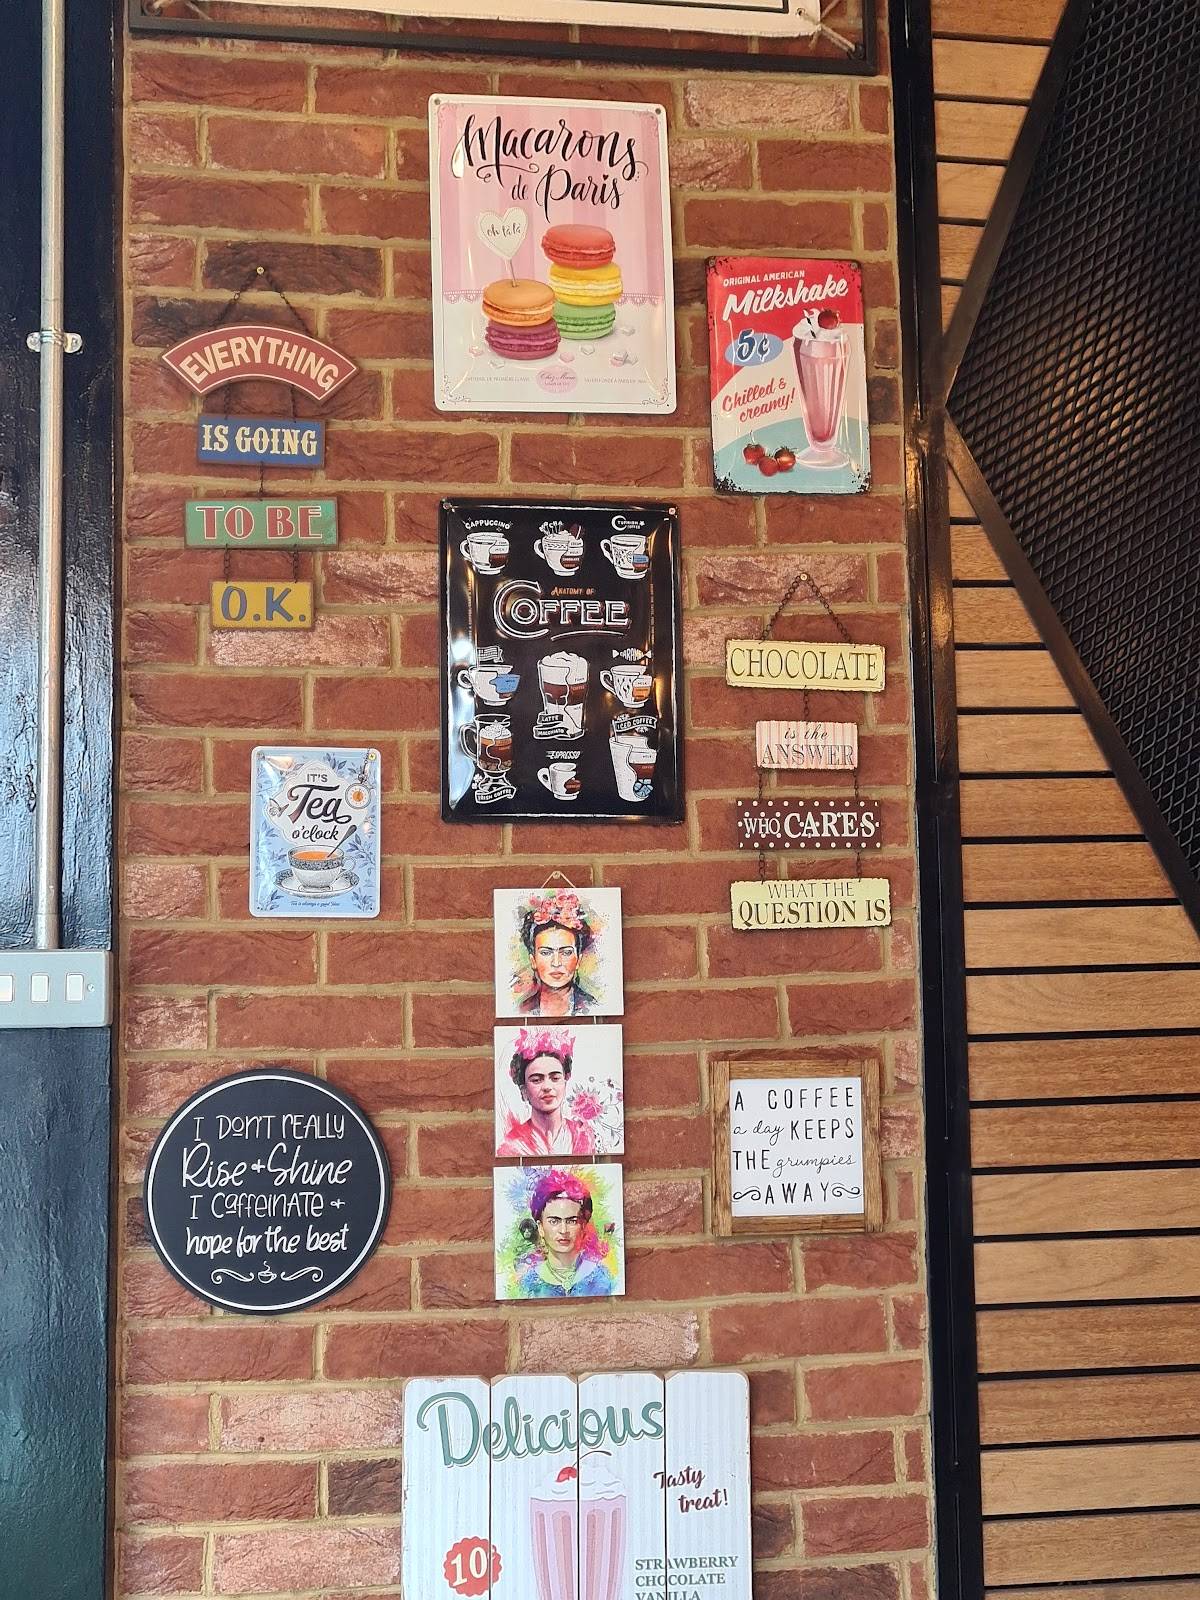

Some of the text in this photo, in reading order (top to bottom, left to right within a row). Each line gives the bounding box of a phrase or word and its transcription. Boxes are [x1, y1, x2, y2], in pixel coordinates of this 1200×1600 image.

[452, 114, 649, 187] Macarons
[511, 164, 624, 224] de Paris
[723, 270, 806, 287] ORIGINAL AMERICAN
[722, 274, 849, 322] Milkshake
[736, 328, 771, 363] 5¢
[178, 335, 340, 392] EVERYTHING
[722, 377, 787, 412] Chilled &
[739, 387, 796, 423] creamy!
[202, 424, 318, 456] IS GOING
[195, 504, 323, 540] TO BE
[465, 519, 511, 530] CAPPUCCINO
[220, 585, 306, 623] O.K.
[493, 579, 631, 639] COFFEE
[729, 647, 879, 681] CHOCOLATE
[617, 718, 653, 730] ICED COFFEE
[784, 723, 828, 740] is the
[761, 743, 855, 766] ANSWER
[306, 773, 328, 783] IT'S
[287, 784, 352, 824] Tea
[493, 788, 512, 798] COFFEE
[292, 825, 339, 842] o'clock
[742, 811, 876, 839] WHO CARES
[768, 881, 855, 899] WHAT THE
[739, 898, 887, 927] QUESTION IS
[734, 1087, 854, 1111] A COFFEE
[193, 1116, 205, 1141] I
[733, 1117, 854, 1146] a day KEEPS
[182, 1142, 247, 1188] Rise
[266, 1142, 353, 1187] Shine
[732, 1149, 856, 1178] THE grumpies
[190, 1195, 203, 1219] I
[765, 1181, 830, 1204] AWAY
[186, 1223, 350, 1259] hope for the best
[416, 1391, 665, 1468] Delicious
[653, 1466, 705, 1490] Tasty
[678, 1488, 729, 1514] treat!
[635, 1555, 738, 1571] STRAWBERRY
[635, 1573, 726, 1588] CHOCOLATE
